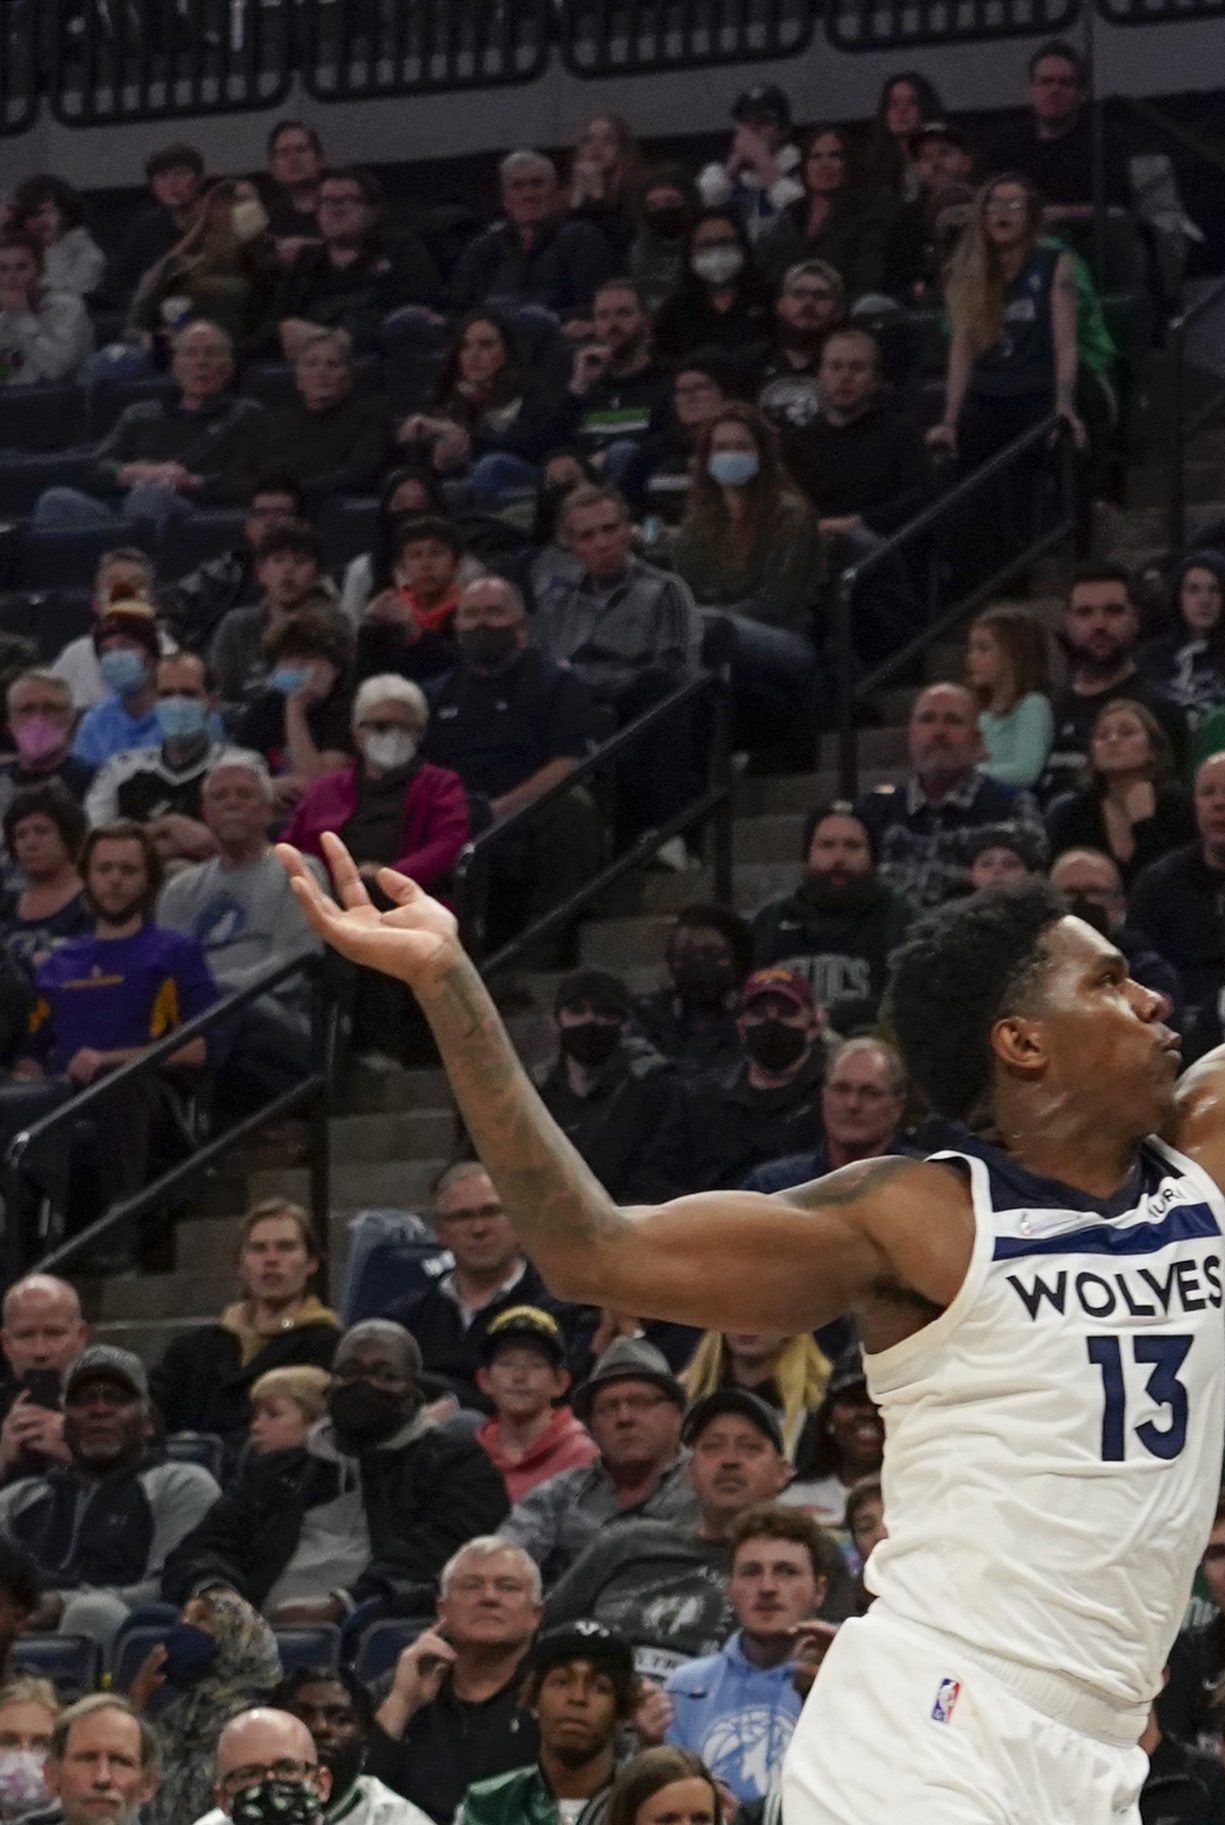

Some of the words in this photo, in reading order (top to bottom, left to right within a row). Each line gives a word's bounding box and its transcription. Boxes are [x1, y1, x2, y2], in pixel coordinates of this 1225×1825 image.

[1148, 1188, 1187, 1218] UR
[1005, 1255, 1222, 1322] WOLVES
[1085, 1333, 1194, 1462] 13
